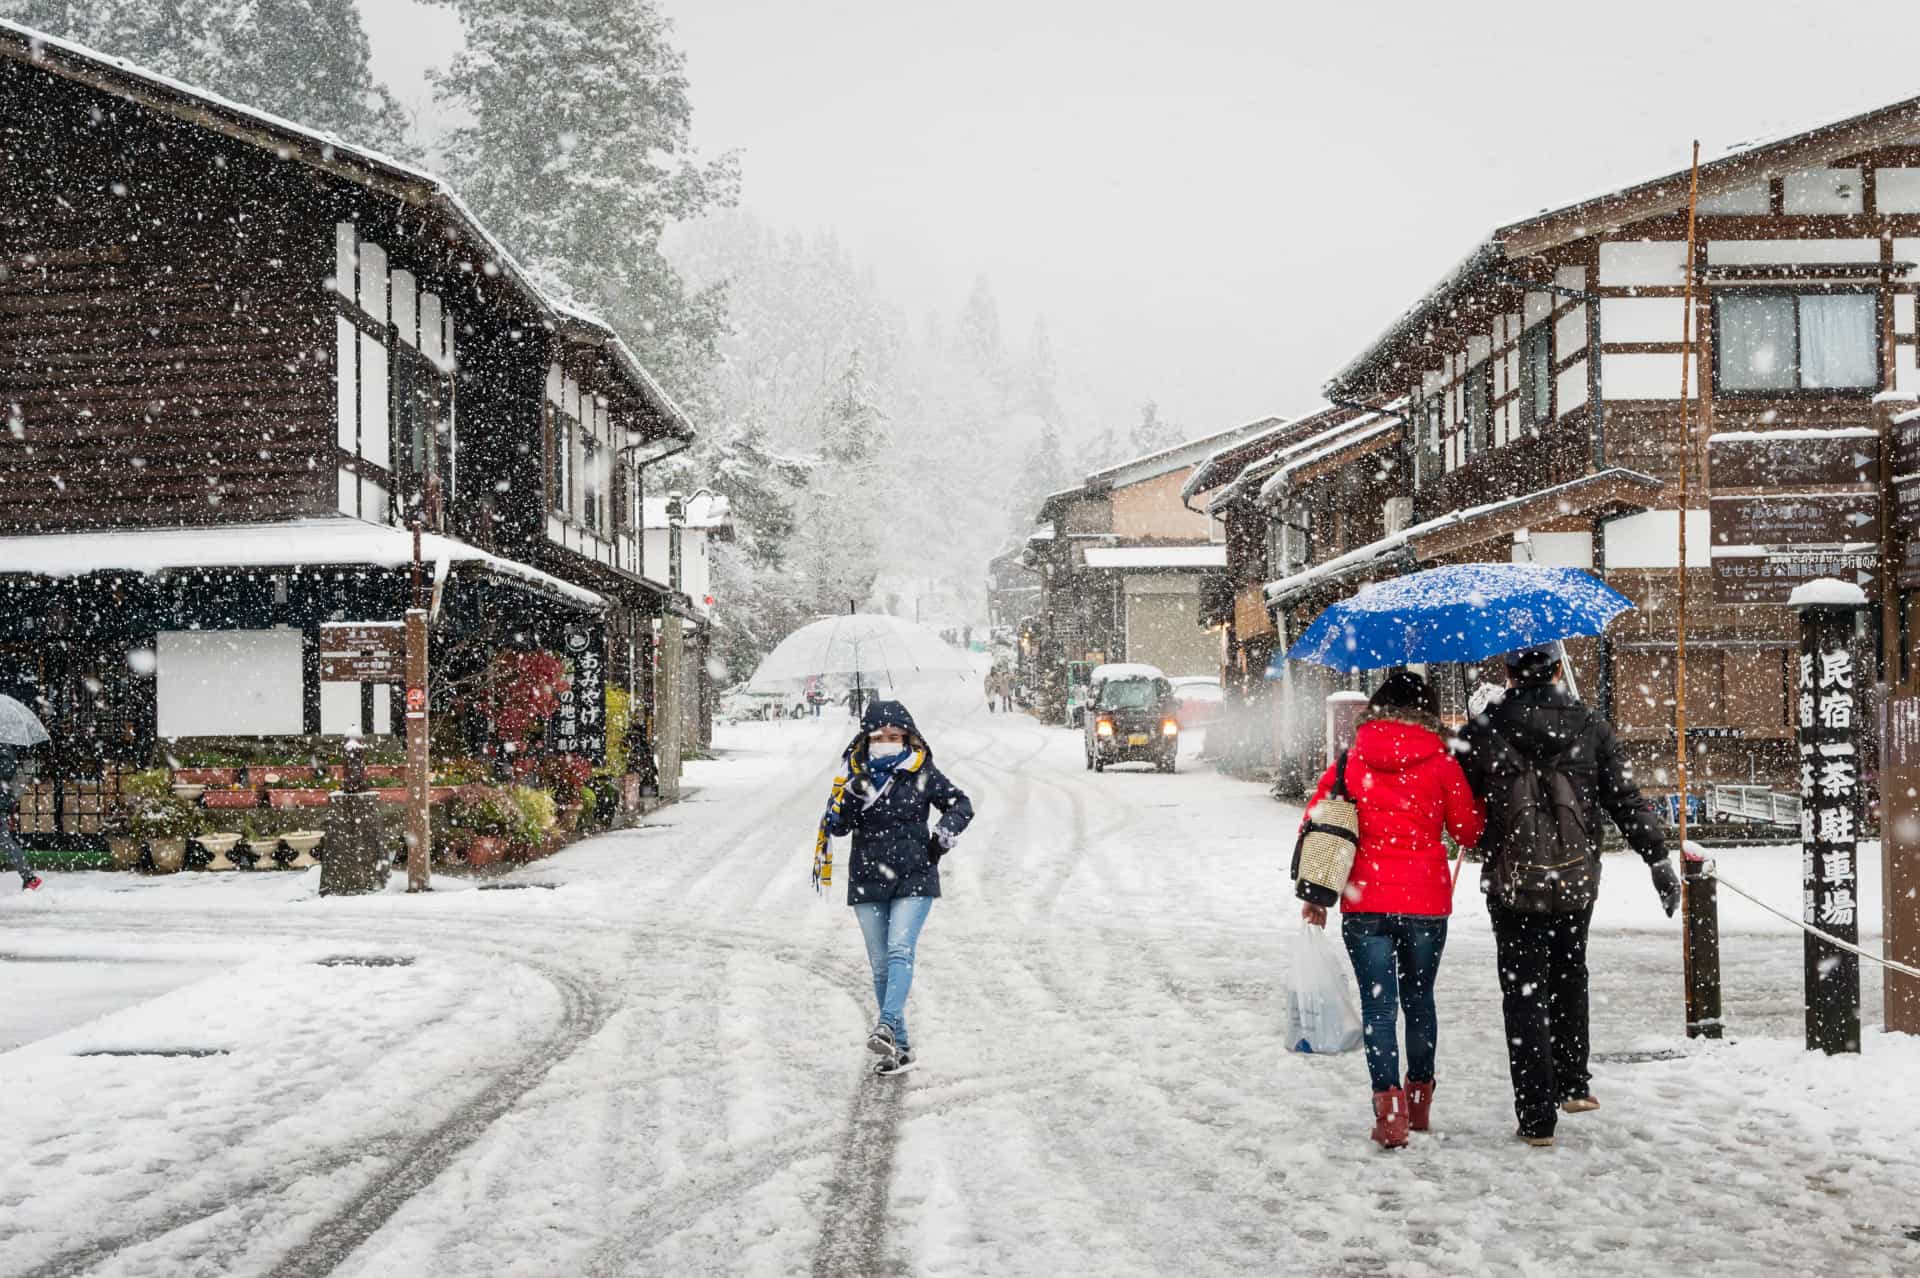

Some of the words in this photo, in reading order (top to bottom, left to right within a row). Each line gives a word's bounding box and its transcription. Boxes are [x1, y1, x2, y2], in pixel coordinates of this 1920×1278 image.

[1720, 563, 1841, 577] せせらぎ公園駐車場
[581, 651, 600, 724] おみやげ
[1819, 649, 1856, 925] 民宿一茶駐車場
